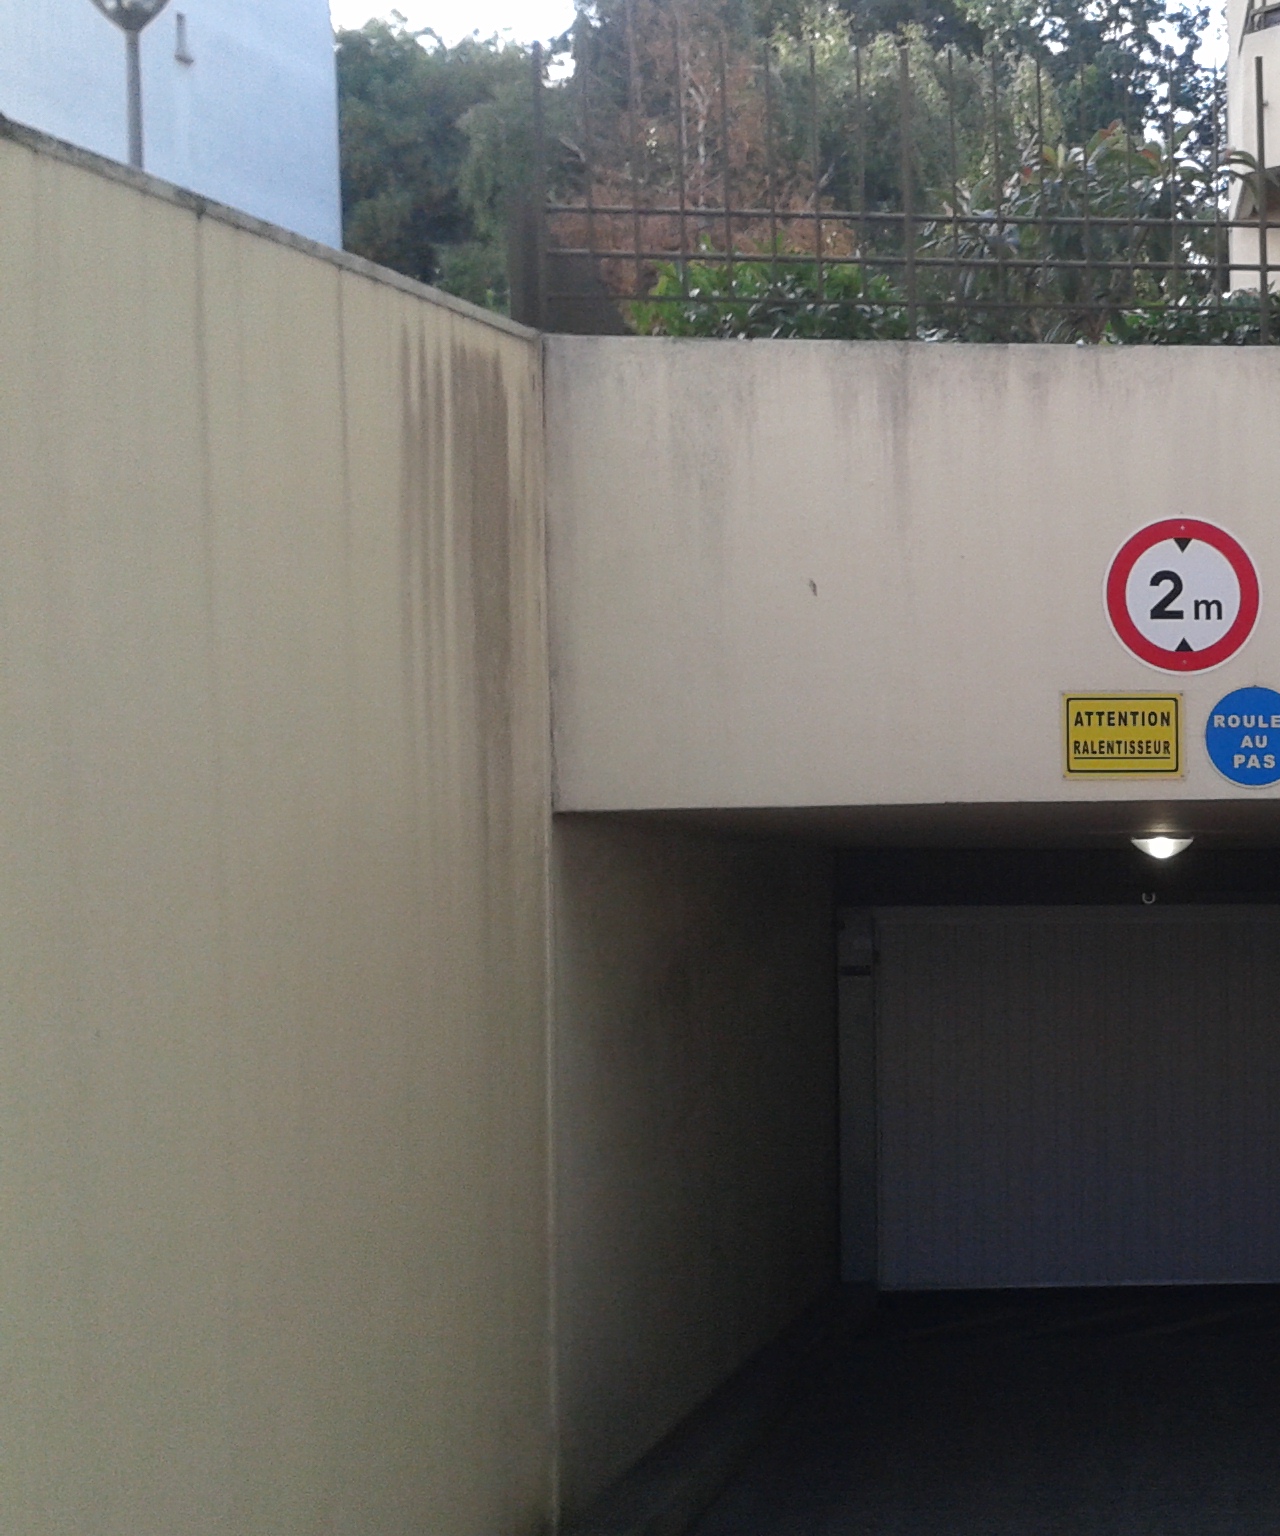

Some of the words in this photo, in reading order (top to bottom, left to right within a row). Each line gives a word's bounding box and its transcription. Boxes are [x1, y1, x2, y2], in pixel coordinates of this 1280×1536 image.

[1149, 570, 1184, 620] 2
[1193, 599, 1223, 620] m
[1074, 711, 1171, 727] ATTENTION
[1073, 740, 1171, 755] RALENTISSEUR
[1240, 735, 1268, 749] AU
[1233, 754, 1276, 769] PAS
